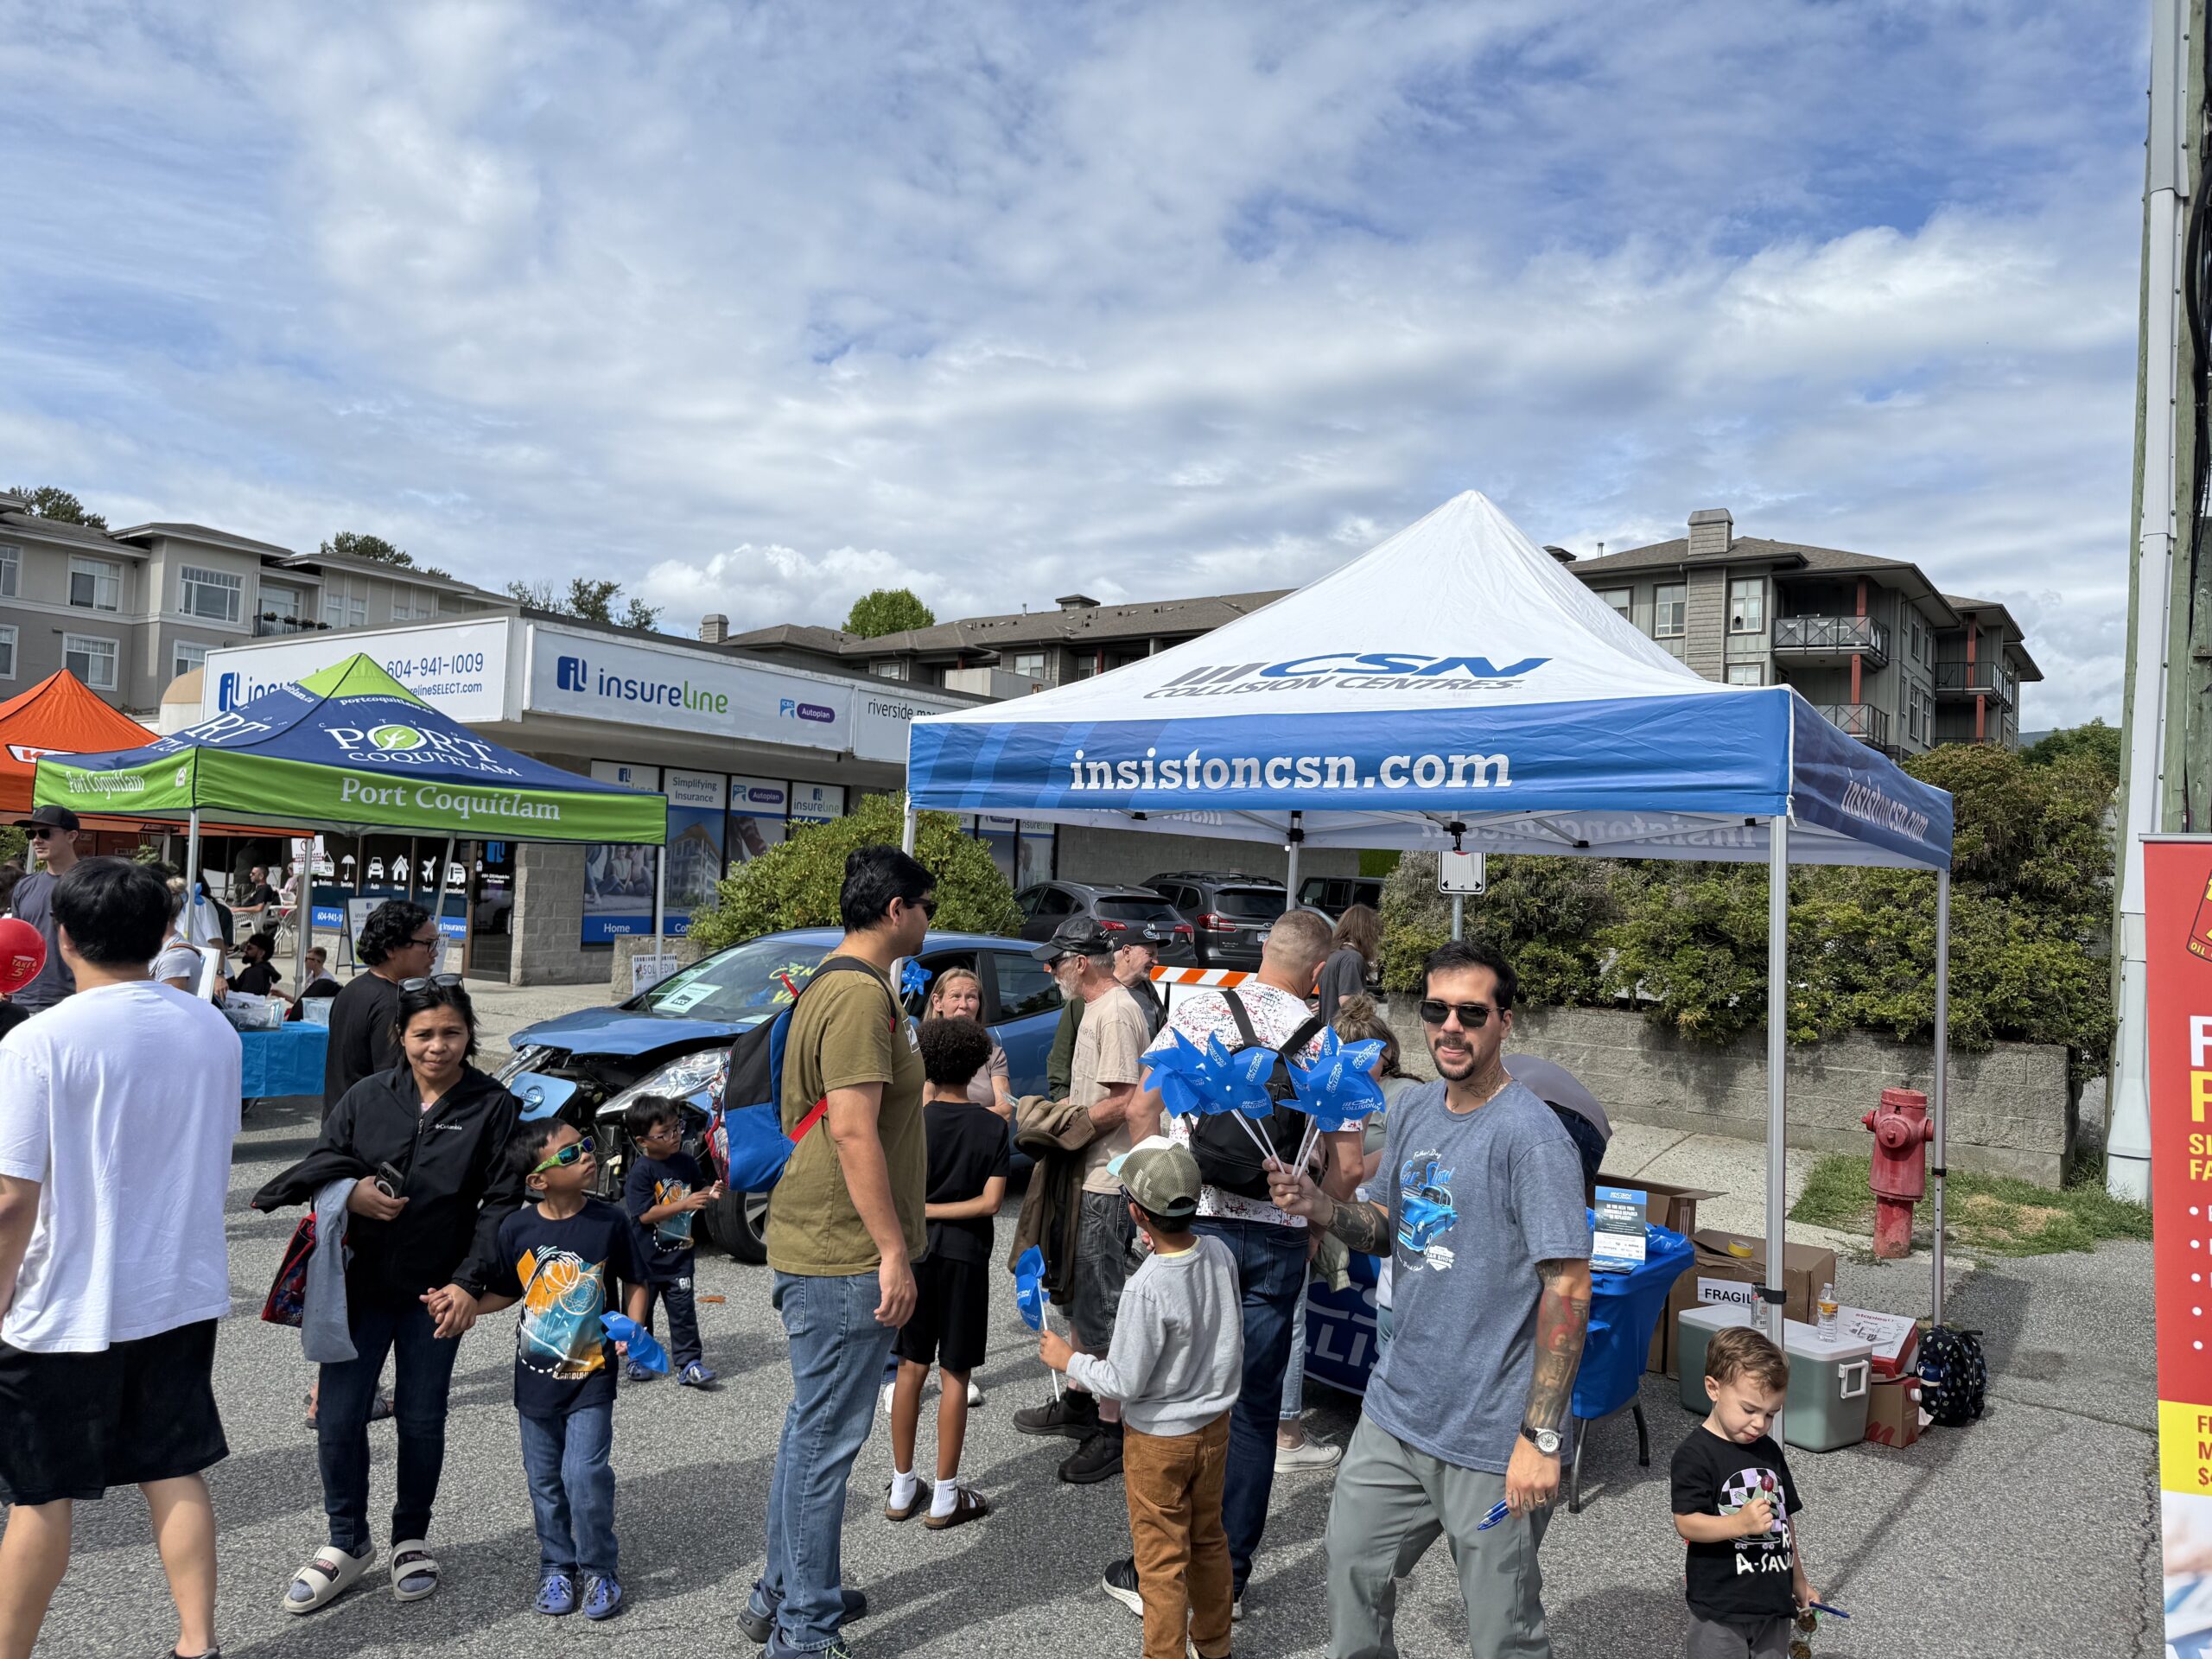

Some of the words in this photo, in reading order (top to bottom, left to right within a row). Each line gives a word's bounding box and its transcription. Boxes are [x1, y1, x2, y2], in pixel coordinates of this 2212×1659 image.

[386, 652, 484, 679] 604-941-1009
[1259, 652, 1554, 678] CSN
[598, 668, 728, 714] insureline
[1143, 677, 1334, 699] COLLISION
[1335, 676, 1516, 691] CENTRES
[802, 708, 830, 719] Autoplan
[868, 698, 913, 721] riverside
[324, 724, 498, 764] PORT
[348, 751, 523, 777] COQUITLAM
[1070, 747, 1512, 791] insistoncsn.com
[65, 771, 89, 793] Port
[86, 769, 145, 800] Coquitlam
[672, 776, 717, 791] Simplifying
[340, 777, 407, 806] Port
[415, 785, 561, 821] Coquitlam
[675, 790, 714, 803] Insurance
[753, 792, 780, 802] Autoplan
[793, 800, 840, 814] insureline
[1840, 767, 1929, 843] insistoncsn.com
[443, 922, 467, 932] Insurance
[603, 923, 631, 933] Home
[2190, 942, 2205, 956] OIL
[1704, 1287, 1751, 1304] FRAGIL
